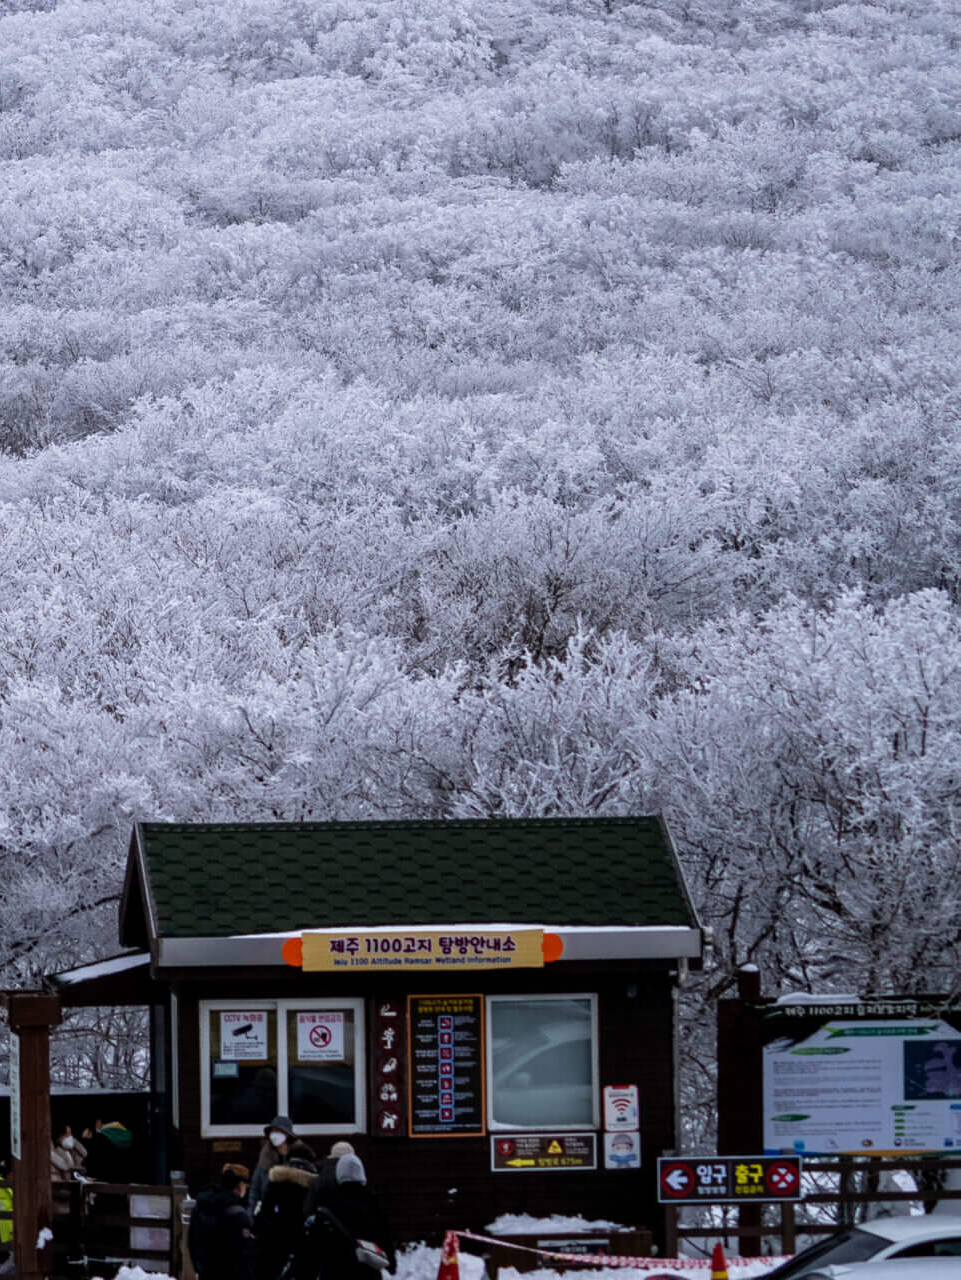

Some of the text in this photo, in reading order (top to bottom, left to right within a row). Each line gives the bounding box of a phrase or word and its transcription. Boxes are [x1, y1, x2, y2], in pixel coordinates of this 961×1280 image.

[329, 935, 515, 955] 제주 1100고지 탐방안내소
[350, 957, 368, 966] 1100
[371, 957, 402, 965] Altitude
[435, 956, 465, 964] Wetland
[467, 955, 511, 963] Information
[809, 1006, 854, 1016] 1100고지
[696, 1164, 727, 1184] 입구
[735, 1164, 763, 1184] 출구
